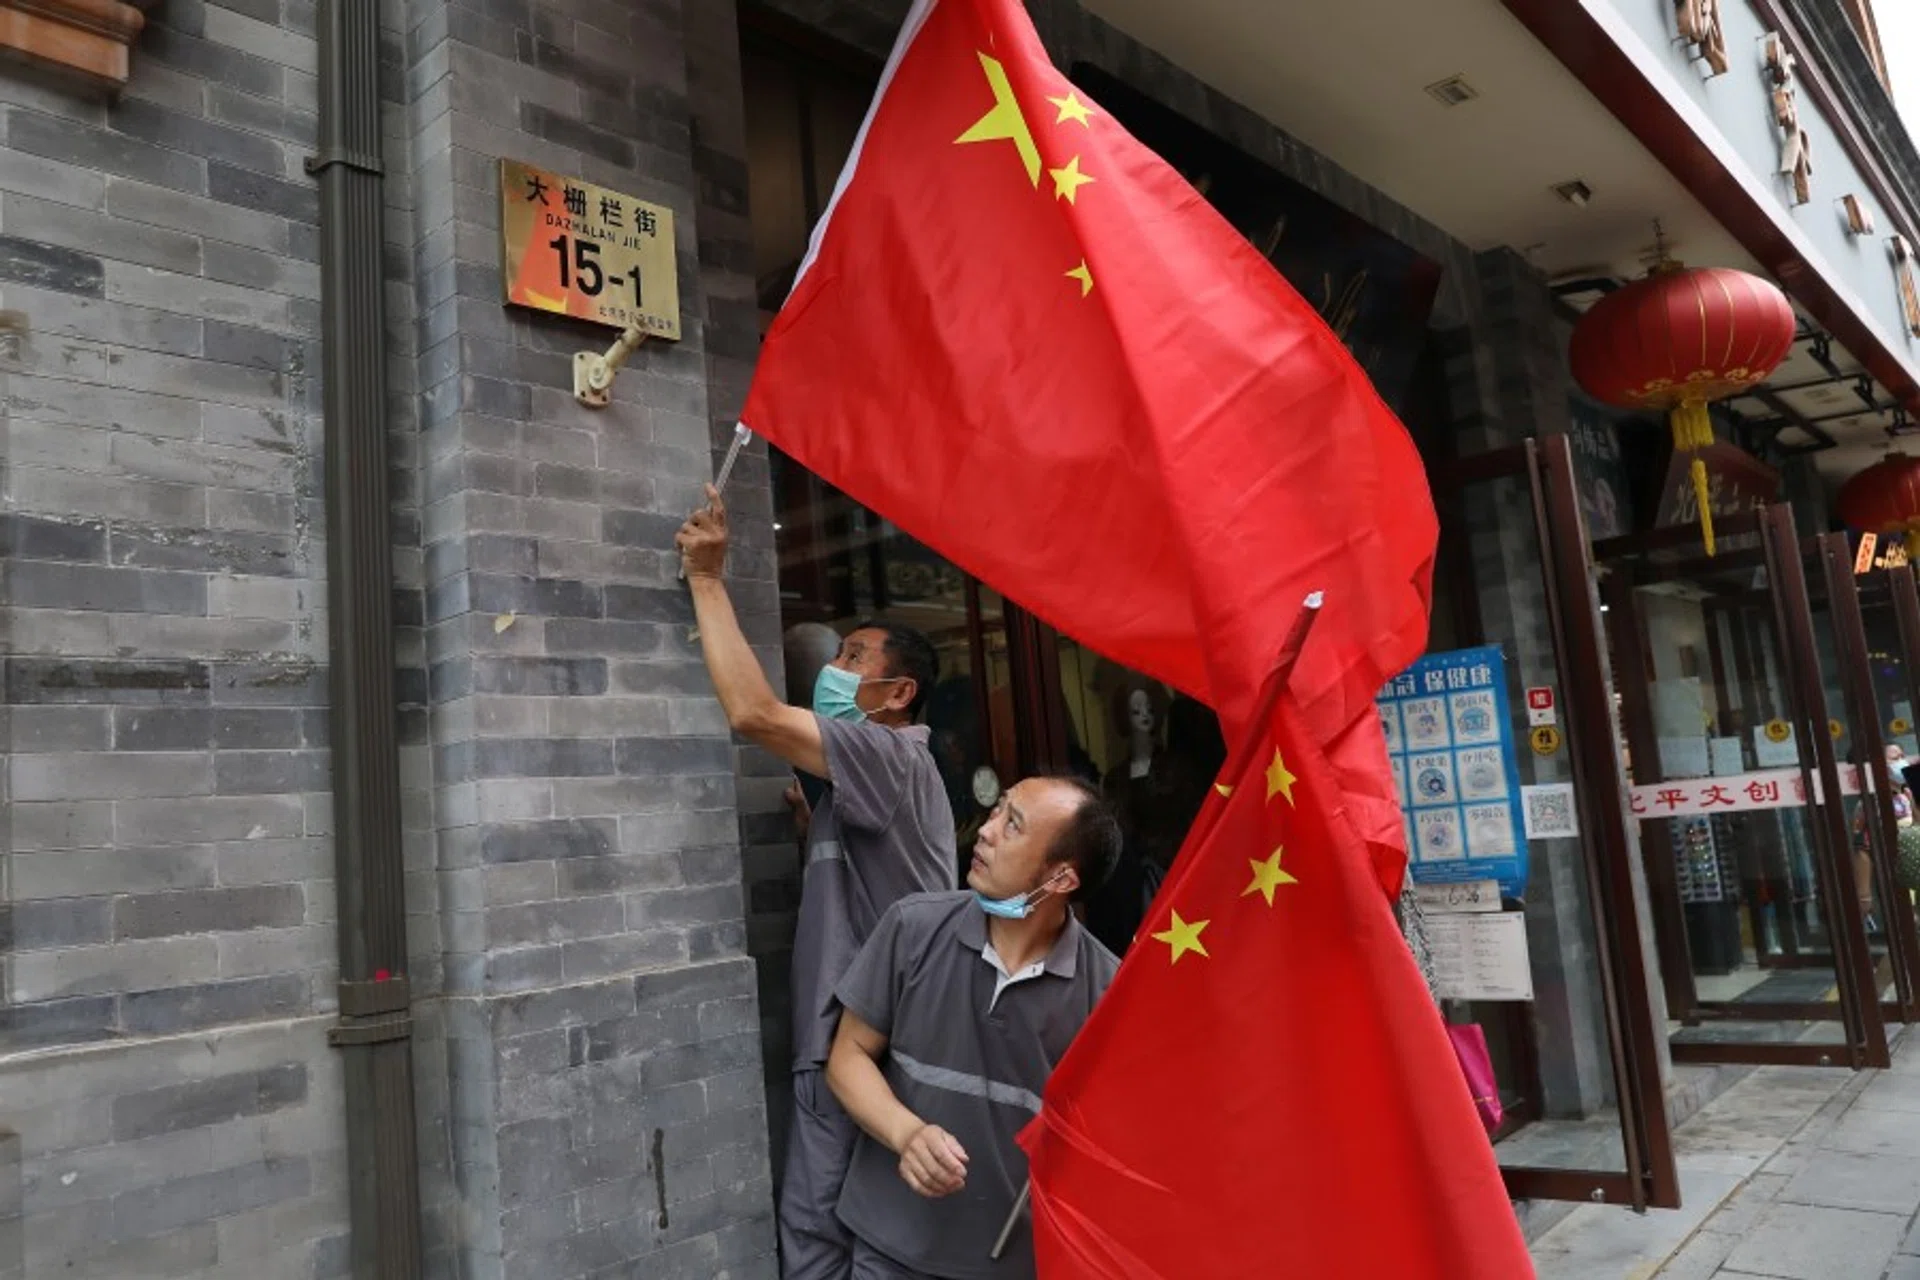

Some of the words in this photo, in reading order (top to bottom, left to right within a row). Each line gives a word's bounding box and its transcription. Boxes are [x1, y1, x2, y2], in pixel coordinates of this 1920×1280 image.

[526, 175, 656, 238] 大栅栏街
[546, 213, 616, 243] DAZHALAN
[623, 236, 641, 250] JIE
[550, 234, 642, 308] 15-1
[1425, 664, 1492, 692] 保健康
